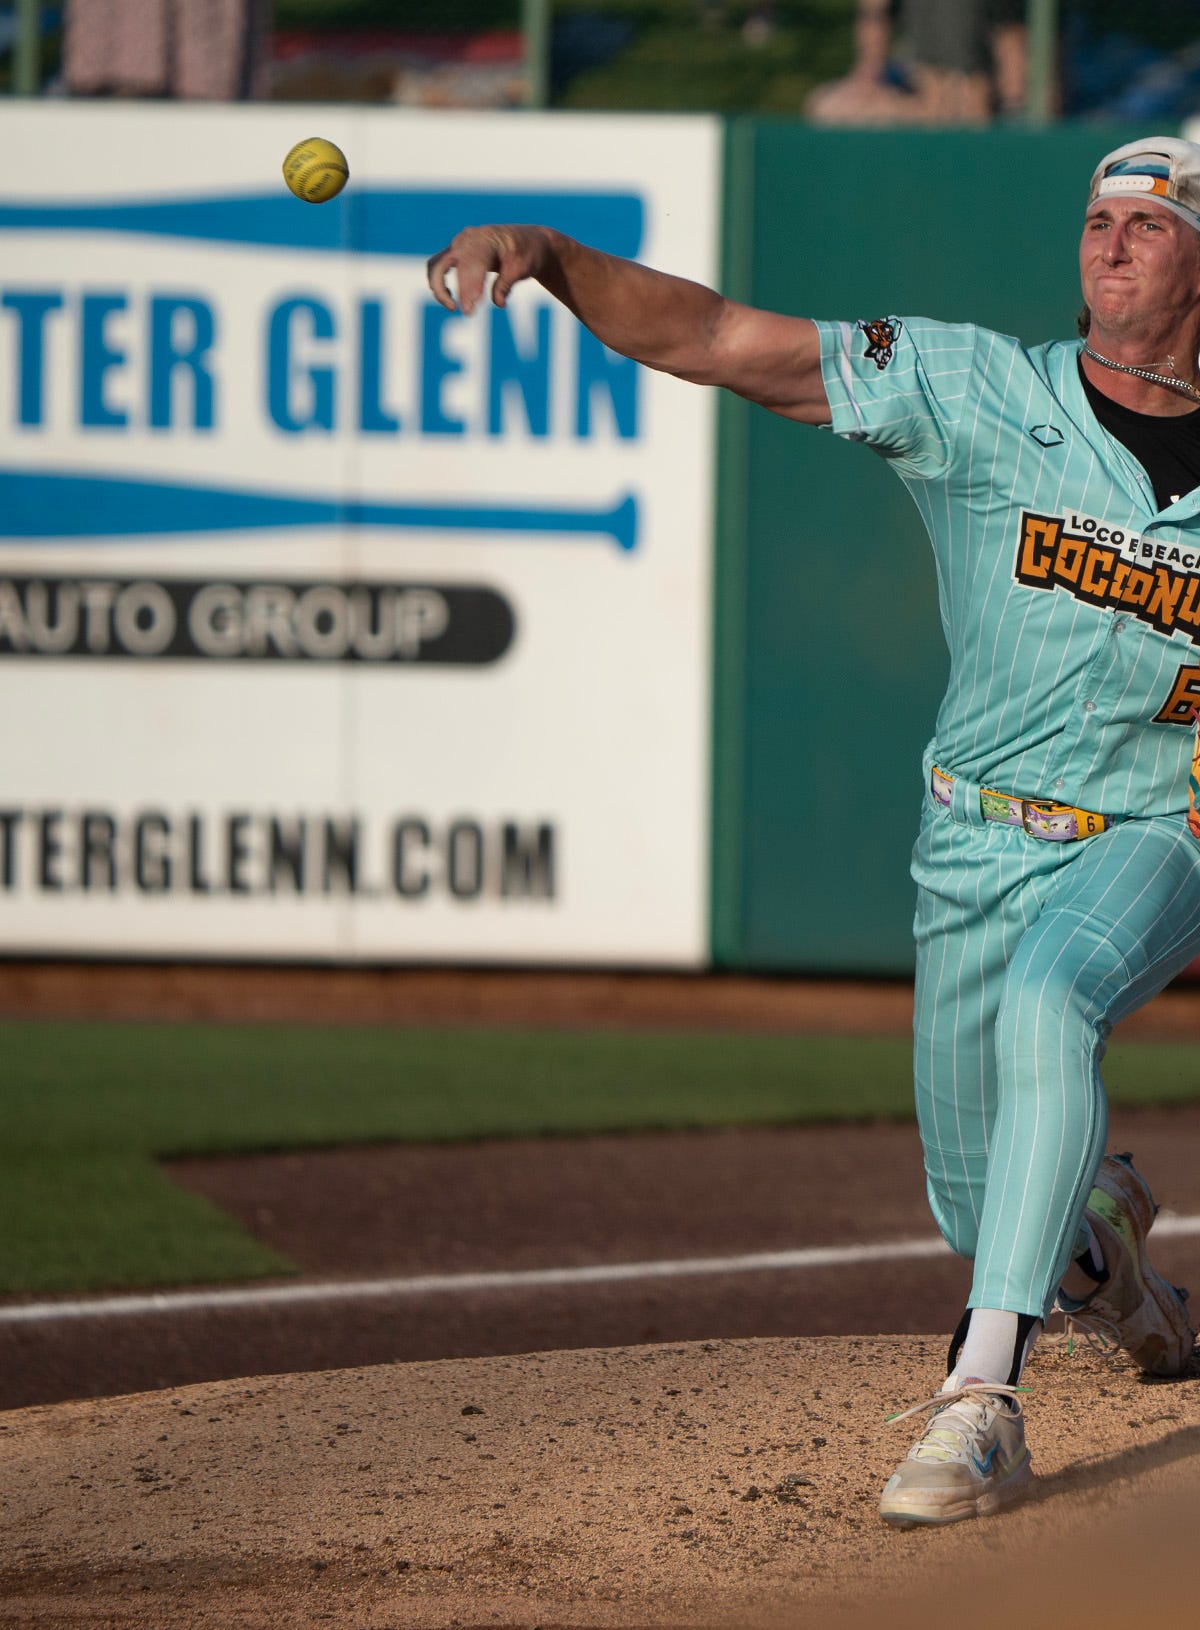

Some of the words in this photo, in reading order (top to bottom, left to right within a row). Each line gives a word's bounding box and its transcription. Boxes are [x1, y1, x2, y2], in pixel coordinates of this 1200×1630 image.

[0, 290, 217, 432] TER
[264, 292, 641, 442] GLENN
[1071, 515, 1125, 545] LOCO
[188, 583, 450, 661] GROUP
[1087, 815, 1096, 832] 6
